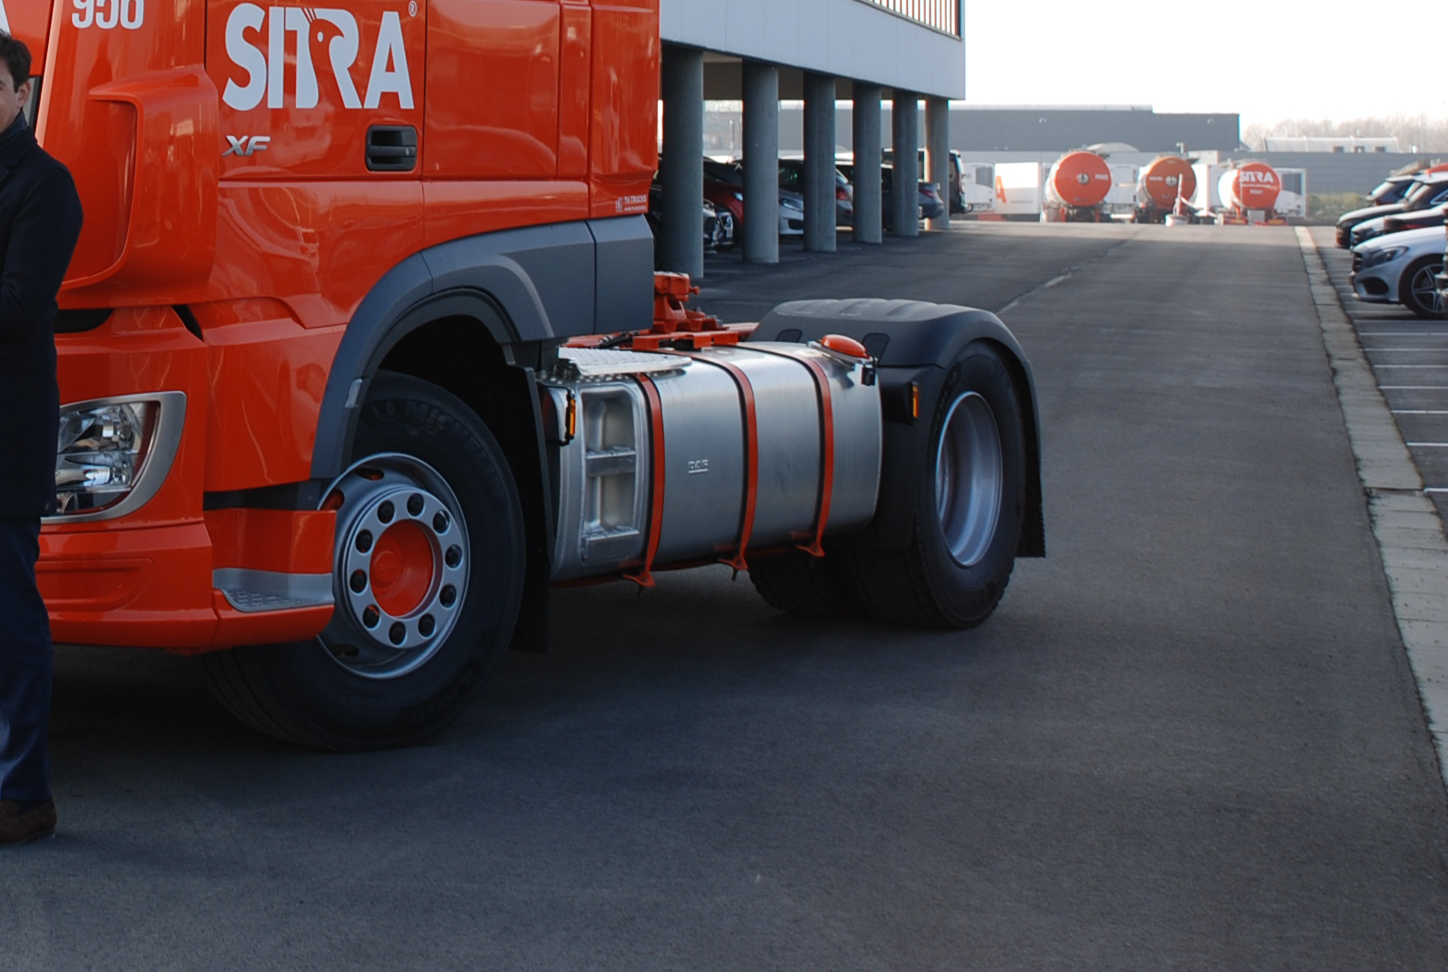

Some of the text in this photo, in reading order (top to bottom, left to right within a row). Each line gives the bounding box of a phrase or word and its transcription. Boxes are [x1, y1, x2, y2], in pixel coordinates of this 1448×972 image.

[222, 2, 415, 111] SITRA
[221, 135, 271, 157] XF
[1239, 171, 1274, 183] SITRA
